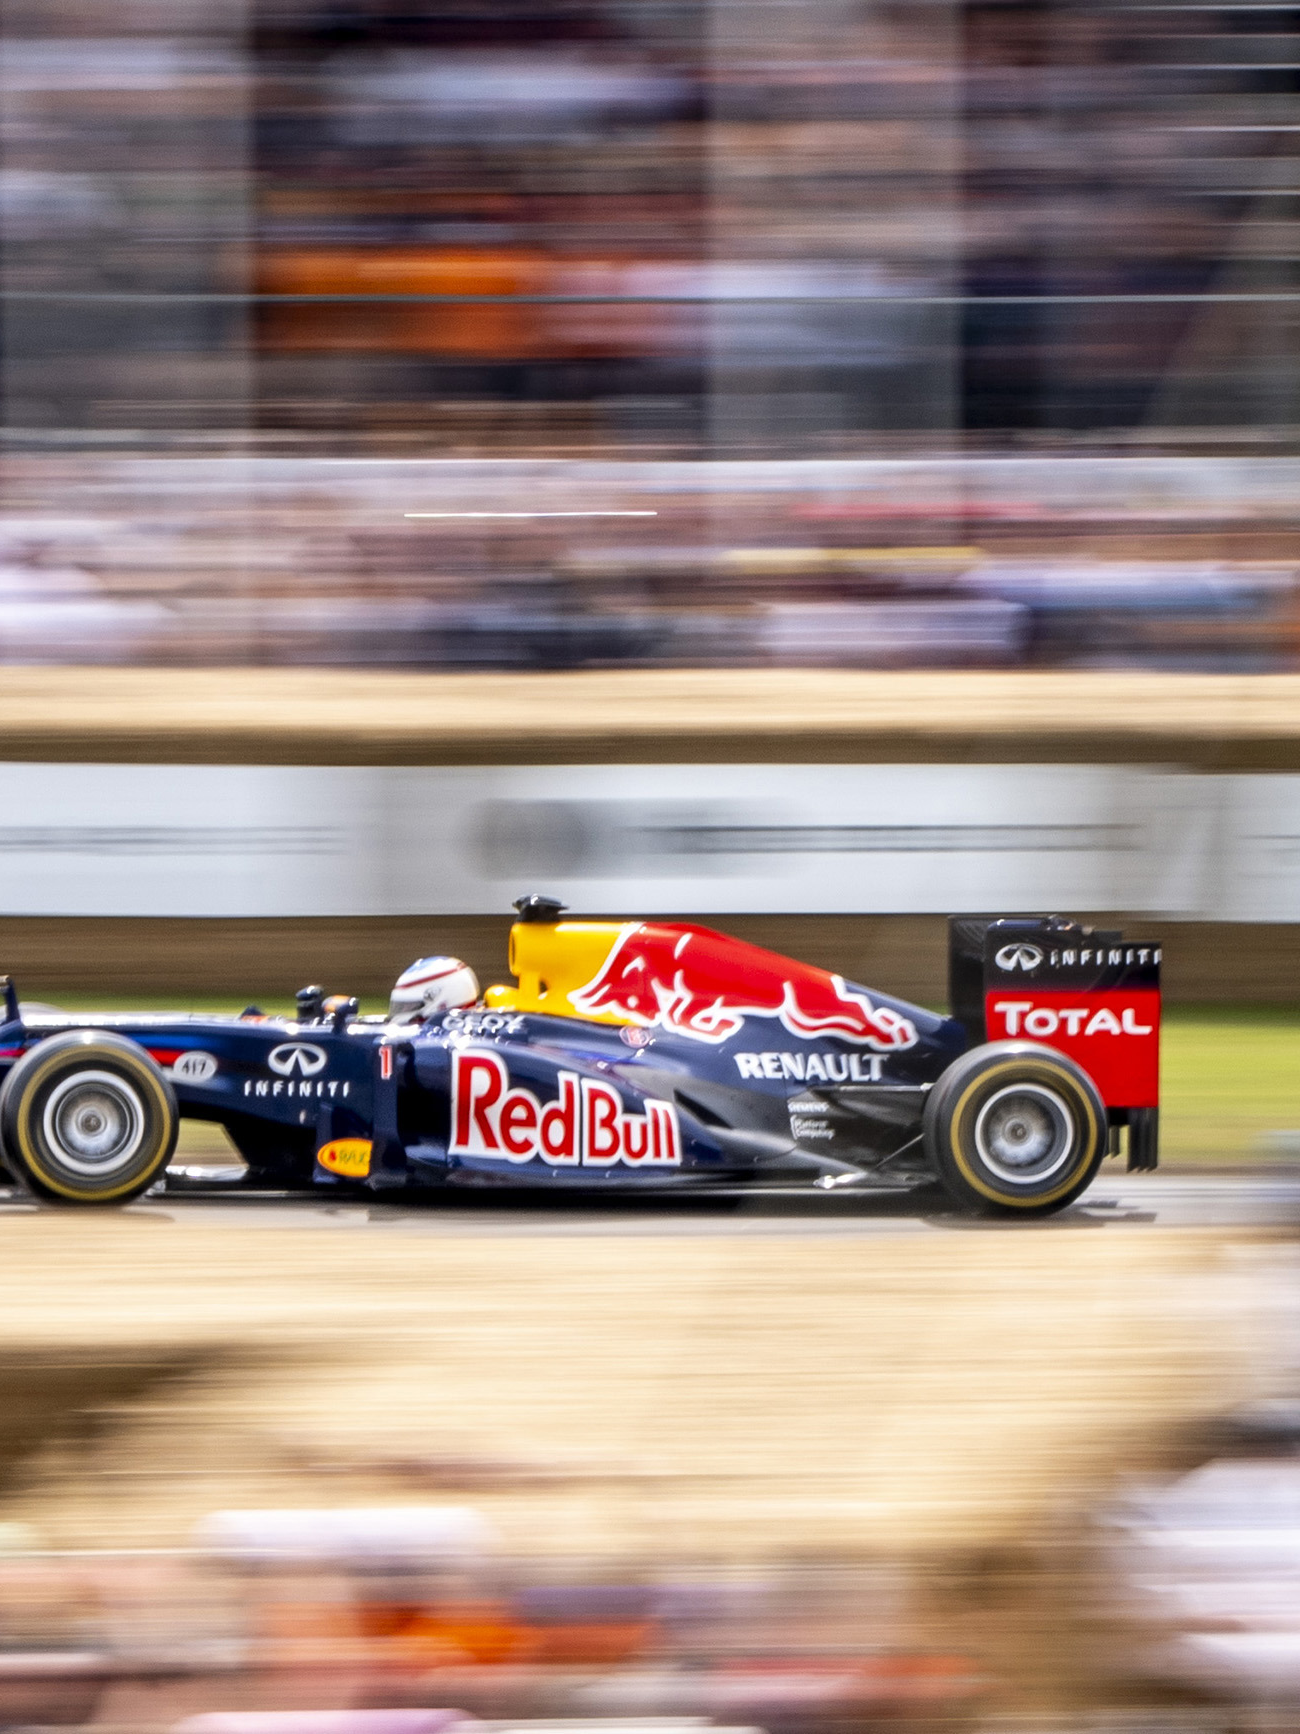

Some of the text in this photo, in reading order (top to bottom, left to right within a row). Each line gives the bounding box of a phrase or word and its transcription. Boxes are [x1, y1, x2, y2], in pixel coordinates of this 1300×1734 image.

[1050, 949, 1162, 965] INFINITI
[733, 1052, 890, 1082] RENAULT
[244, 1080, 350, 1098] INFINITI
